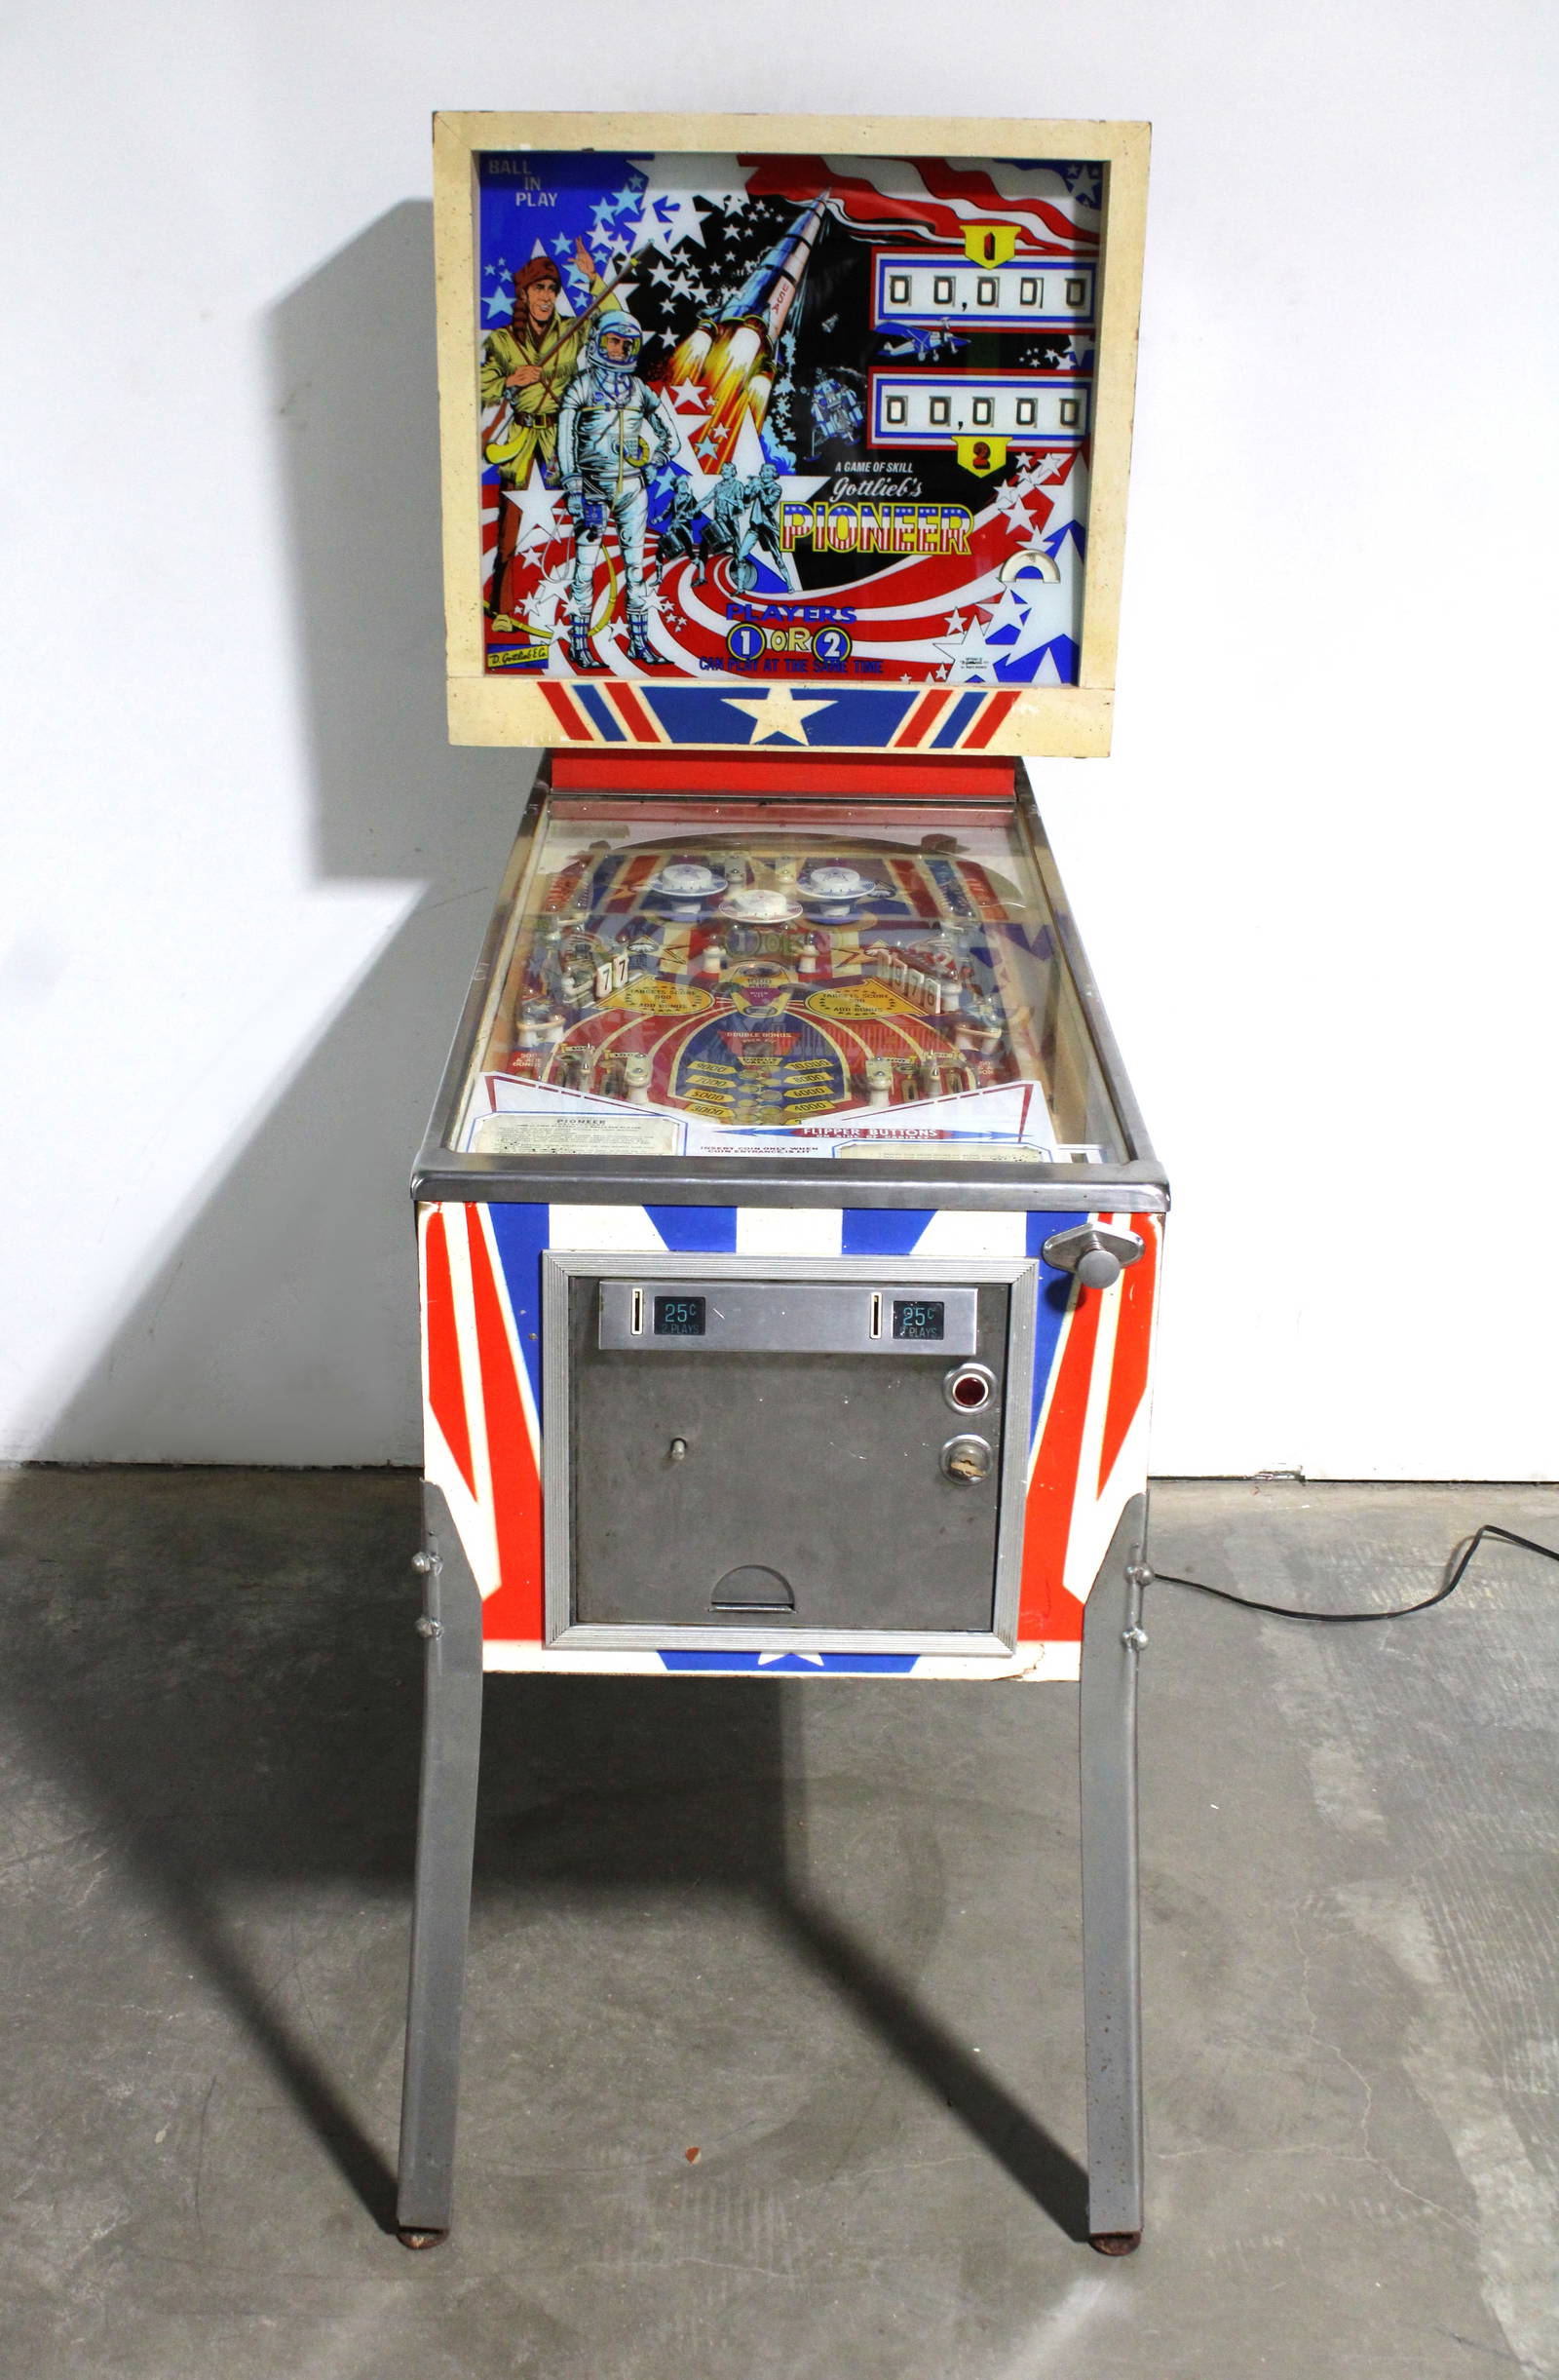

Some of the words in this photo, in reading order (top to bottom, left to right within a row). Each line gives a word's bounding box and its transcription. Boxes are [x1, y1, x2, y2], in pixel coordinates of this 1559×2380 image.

[488, 160, 531, 174] BALL
[524, 176, 541, 191] IN
[515, 191, 558, 207] PLAY
[972, 441, 991, 470] 2
[835, 462, 842, 472] A
[844, 462, 870, 473] GAME
[872, 462, 885, 473] OF
[886, 462, 914, 474] SKILL
[829, 476, 924, 503] Gottlieb's
[780, 500, 974, 556] PIONEER
[726, 602, 857, 625] PLAYERS
[740, 630, 751, 656] 1
[770, 626, 812, 652] OR
[823, 632, 841, 658] 2
[699, 656, 723, 671] CAN
[728, 657, 758, 672] PLAY
[763, 658, 780, 672] AT
[784, 659, 808, 673] THE
[813, 659, 848, 674] SAME
[854, 660, 885, 674] TIME
[697, 1076, 727, 1088] 7000
[693, 1090, 725, 1102] 5000
[794, 1087, 825, 1097] 6000
[691, 1104, 724, 1116] 3000
[794, 1101, 826, 1112] 4000
[670, 1324, 700, 1334] PLAYS
[909, 1326, 936, 1337] PLAYS
